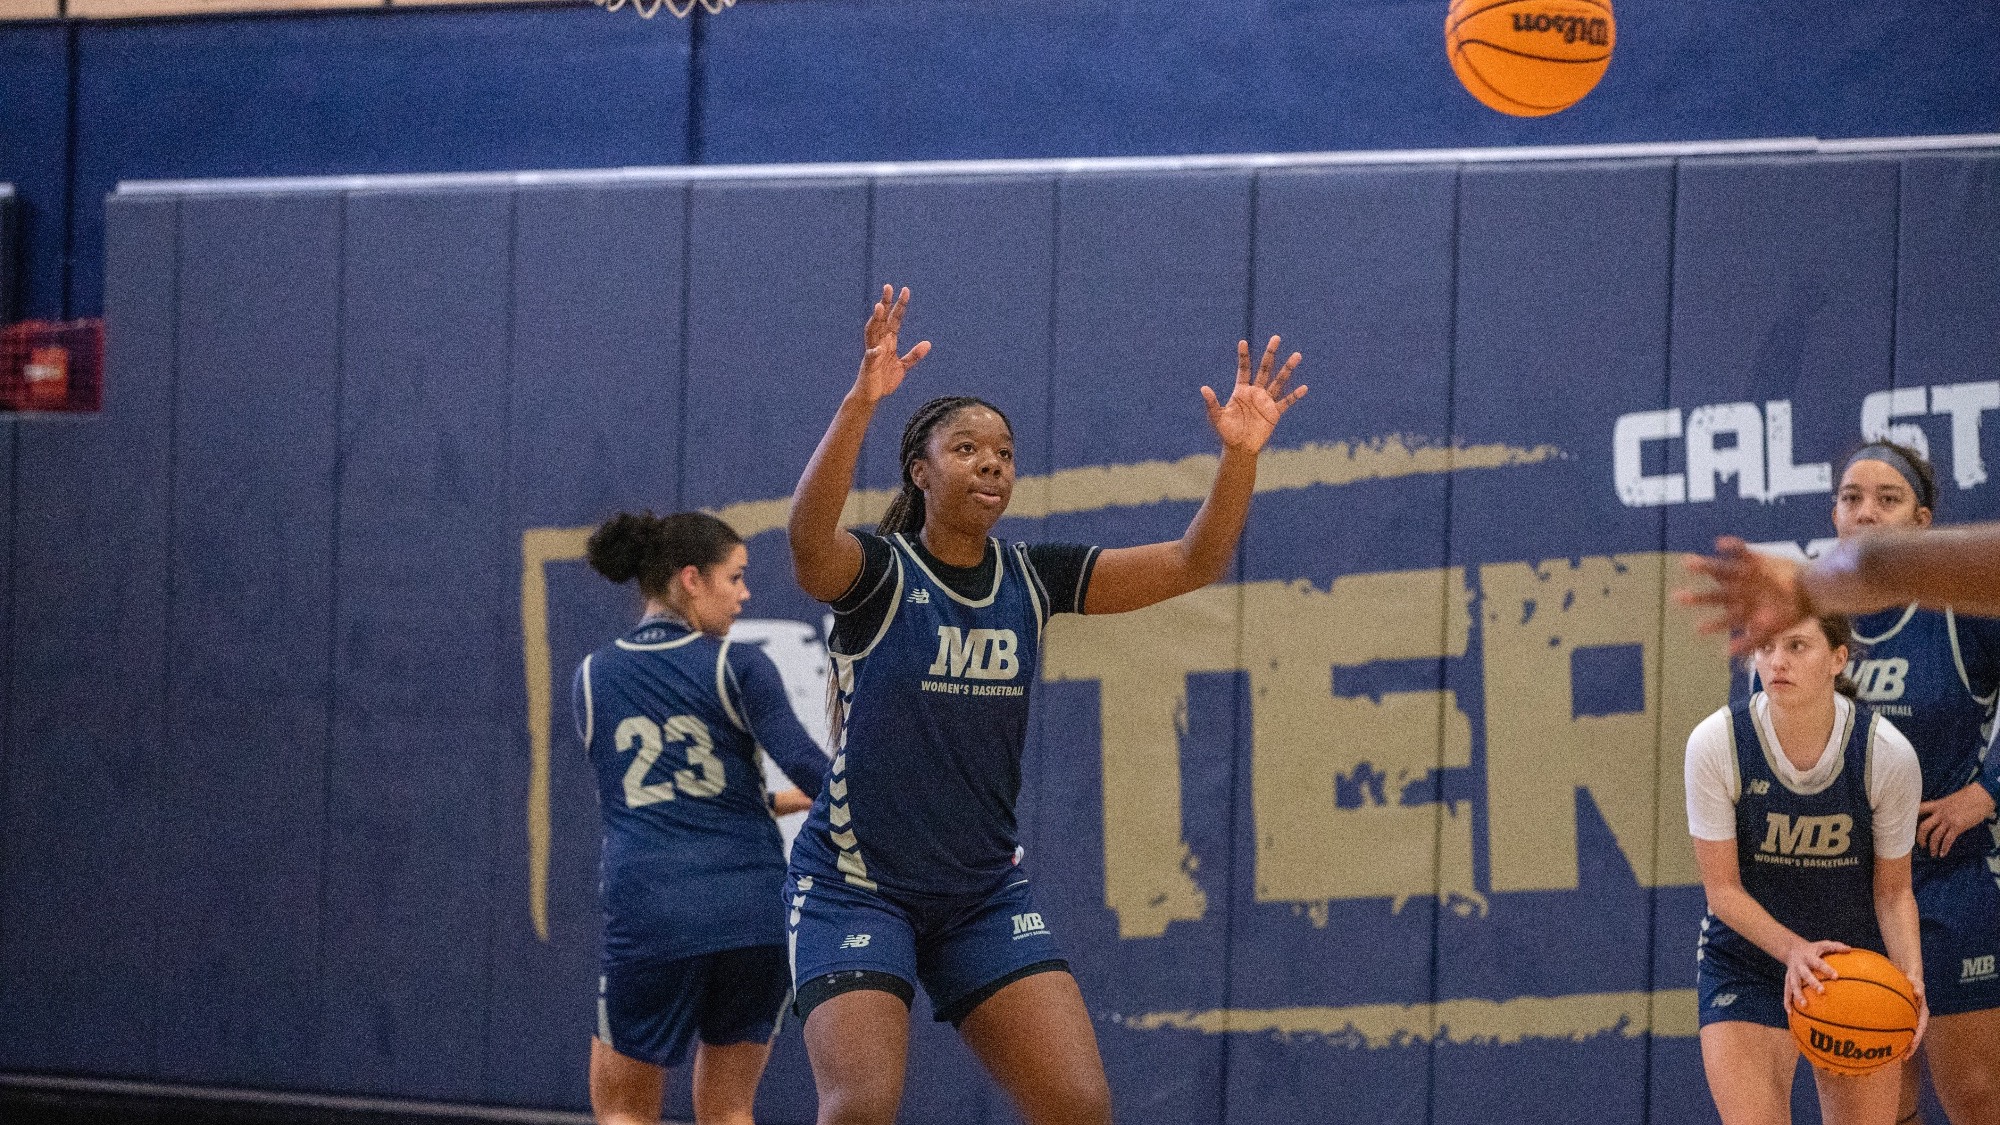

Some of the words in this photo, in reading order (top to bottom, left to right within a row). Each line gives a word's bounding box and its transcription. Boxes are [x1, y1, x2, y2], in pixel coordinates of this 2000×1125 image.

[1512, 13, 1608, 47] Wilson
[1613, 400, 1832, 507] CAL
[929, 625, 1020, 680] MB
[921, 681, 969, 696] WOMEN'S
[972, 685, 1024, 696] BASKETBALL
[614, 715, 727, 809] 23
[1760, 811, 1854, 856] MB
[1754, 854, 1801, 867] WOMEN'S
[1803, 857, 1858, 868] BASKETBALL
[1011, 912, 1045, 935] MB
[1961, 955, 1995, 979] MB
[1810, 1027, 1893, 1060] Wilson
